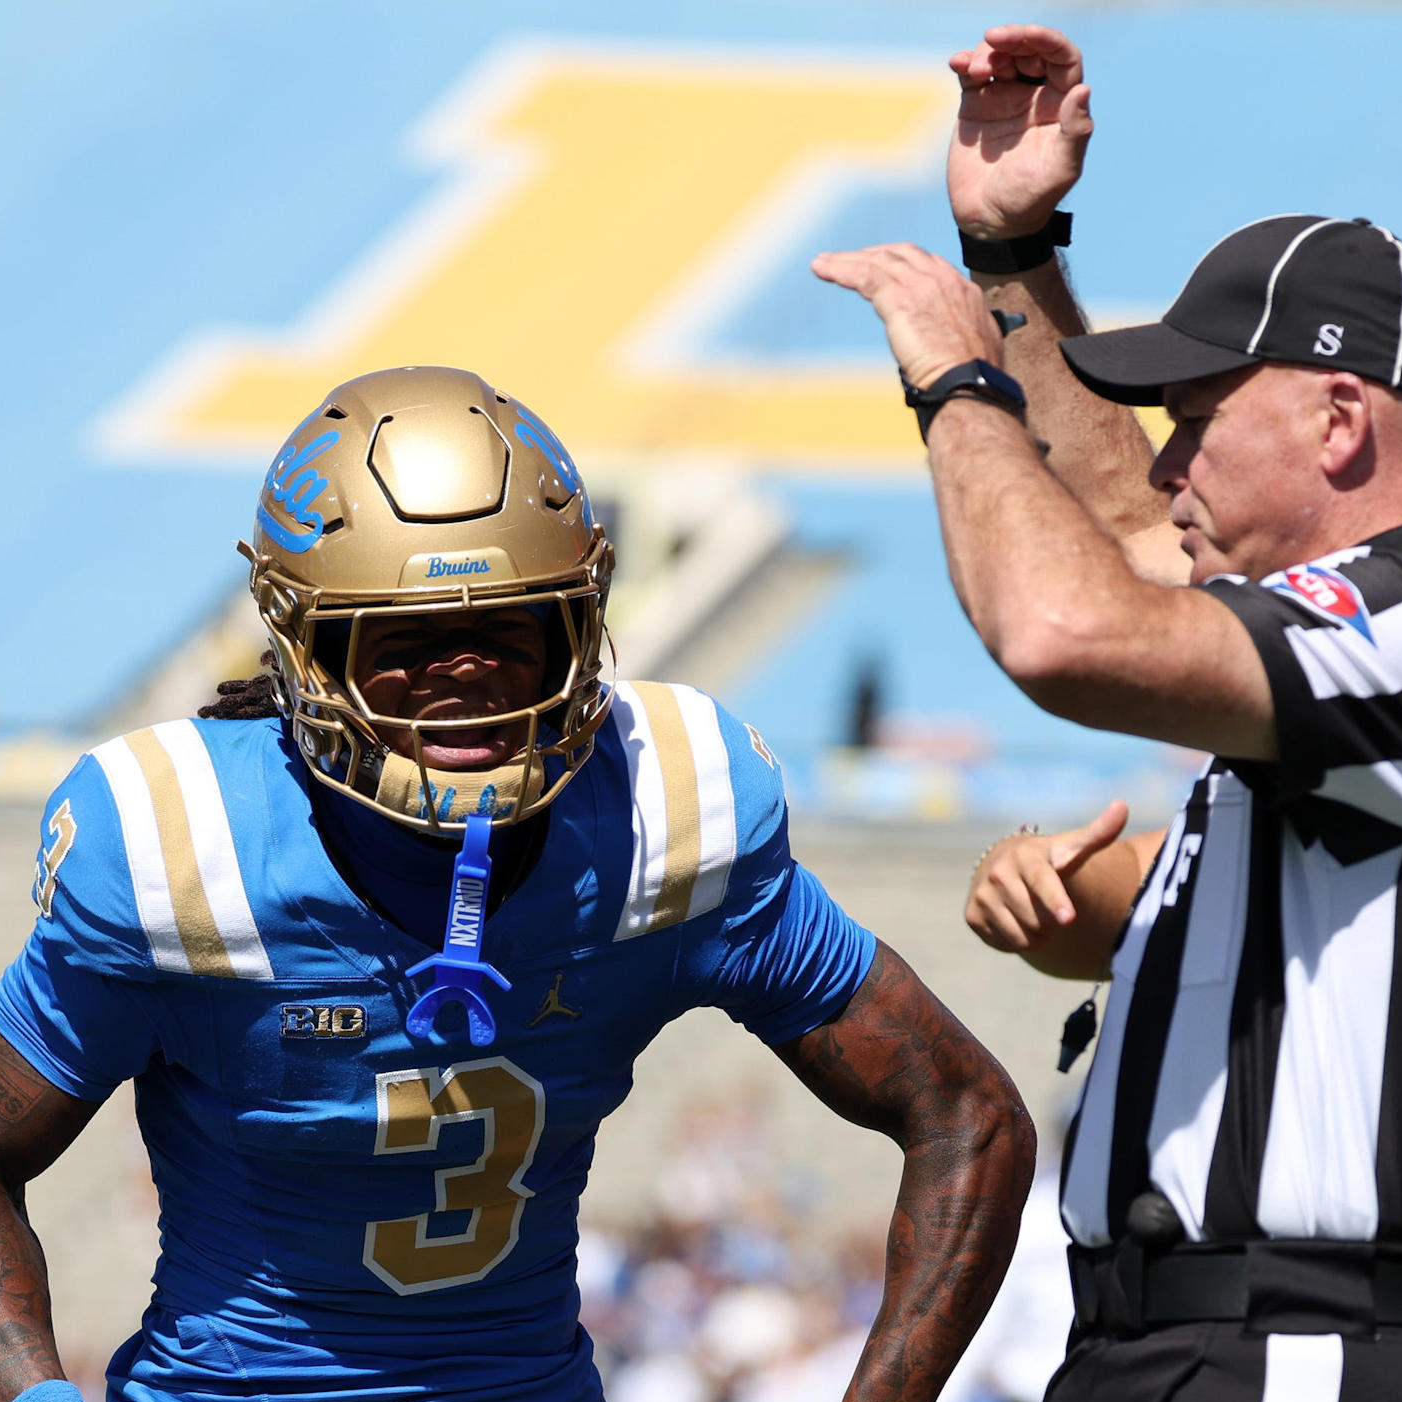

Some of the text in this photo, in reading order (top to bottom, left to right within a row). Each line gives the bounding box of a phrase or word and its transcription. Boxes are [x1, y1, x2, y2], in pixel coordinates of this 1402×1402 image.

[1313, 323, 1345, 356] S
[425, 557, 491, 578] Bruins
[448, 878, 485, 948] NXTRND
[280, 1002, 368, 1039] BIG
[362, 1056, 545, 1296] 3
